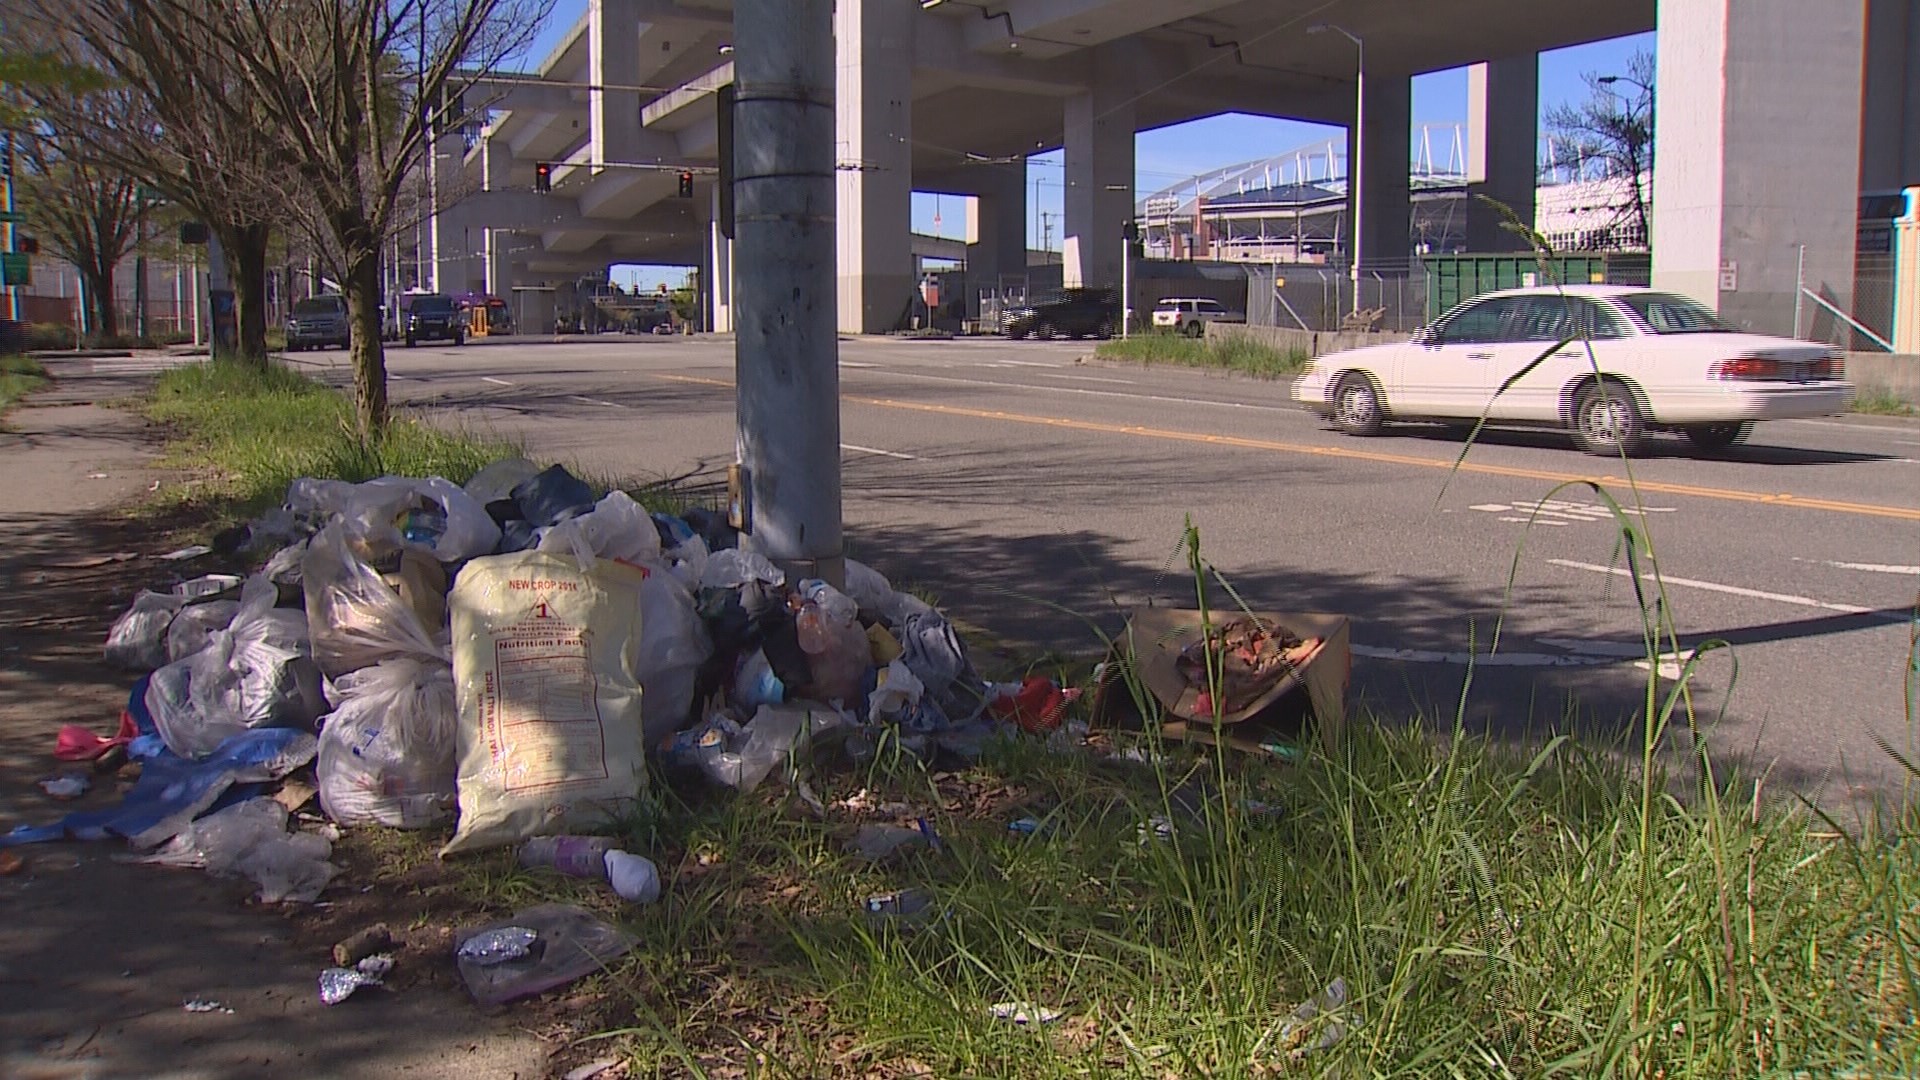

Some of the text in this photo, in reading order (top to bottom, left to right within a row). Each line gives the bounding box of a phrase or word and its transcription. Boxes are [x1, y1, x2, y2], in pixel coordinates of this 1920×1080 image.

[509, 580, 529, 590] NEW
[530, 580, 556, 590] CROP
[536, 603, 552, 618] 1
[499, 639, 553, 650] Nutrition
[485, 671, 494, 694] RICE
[487, 717, 495, 737] HOM
[489, 740, 498, 765] THAI
